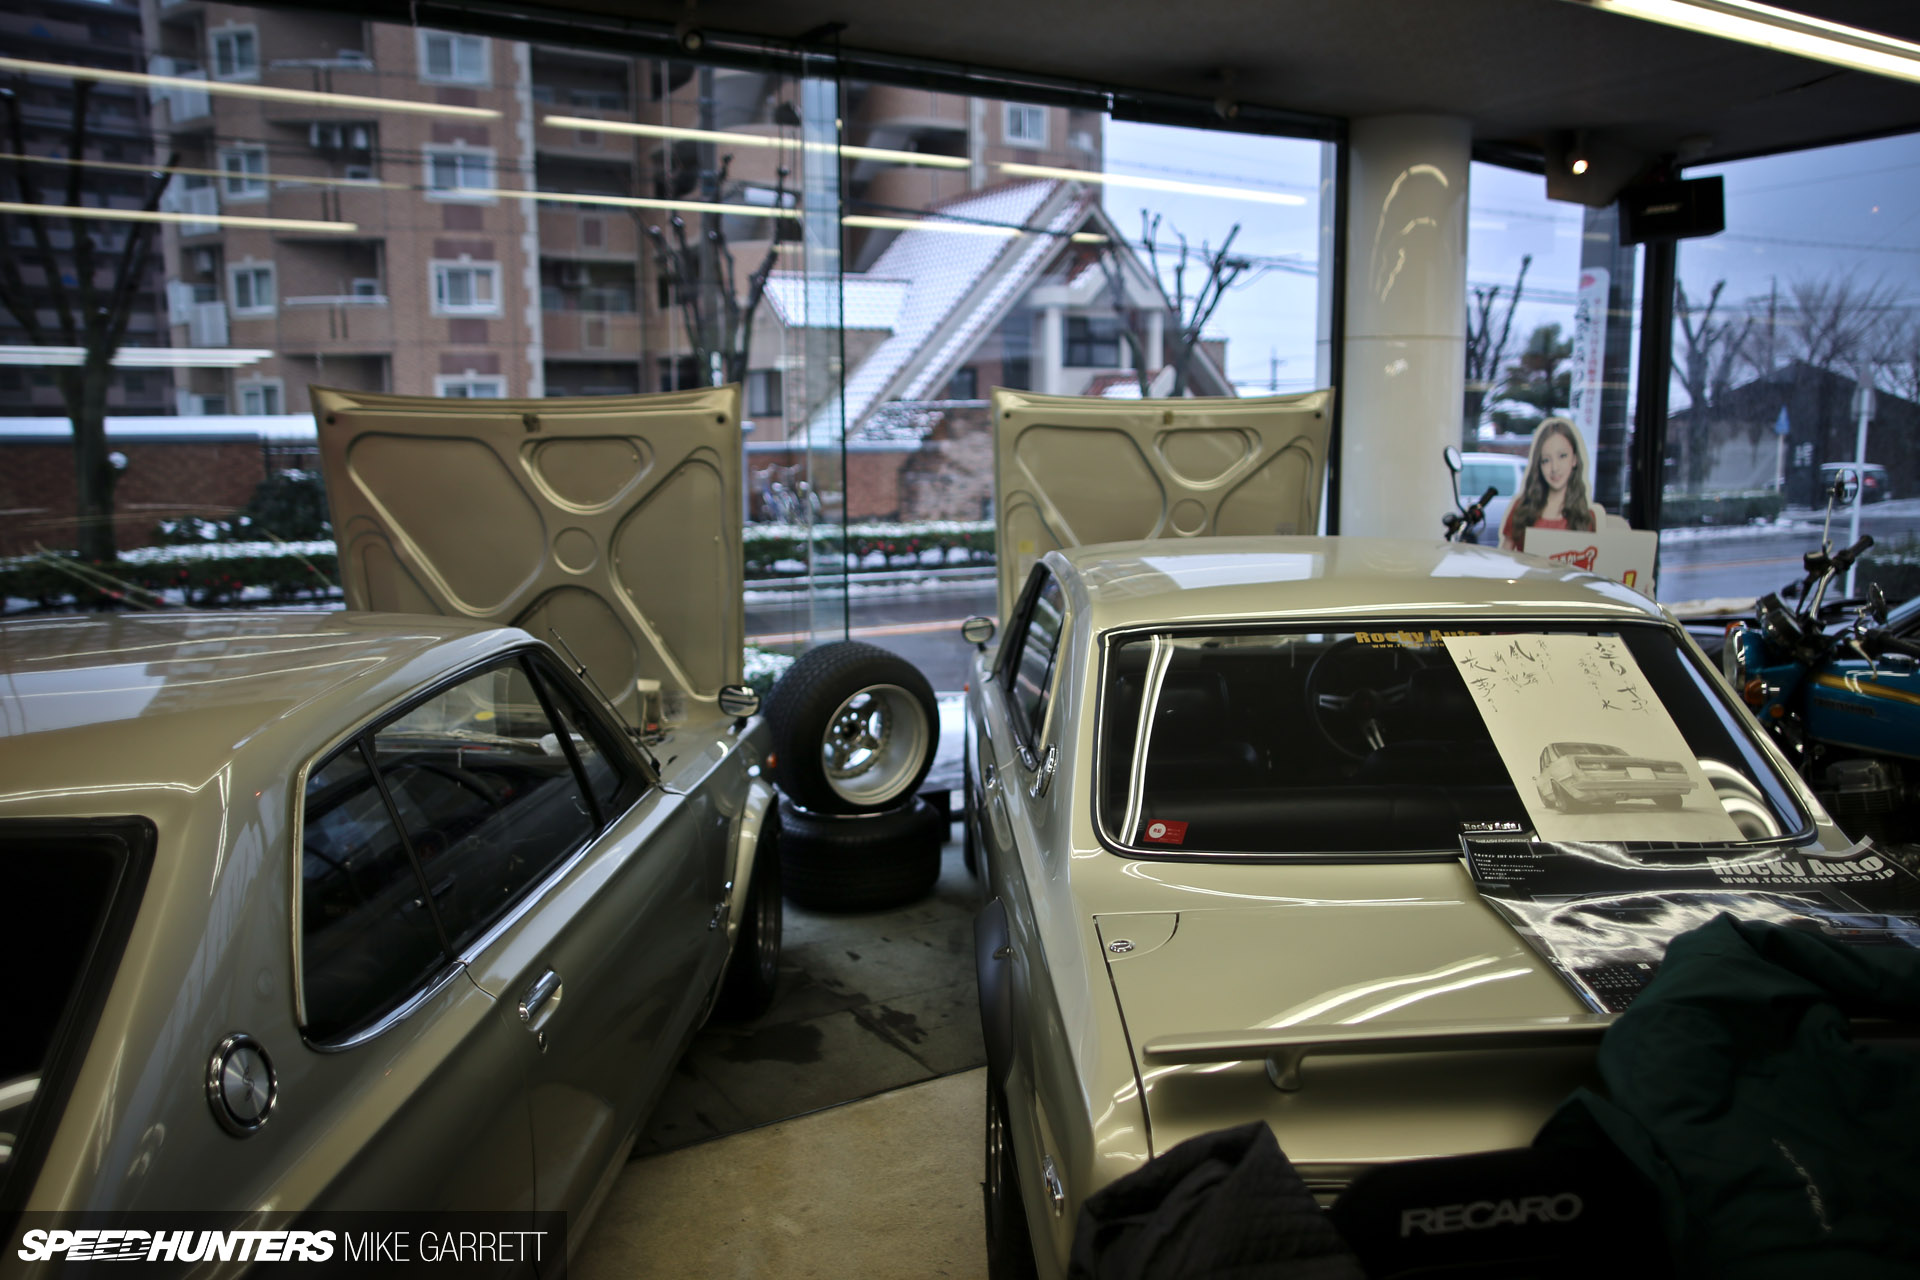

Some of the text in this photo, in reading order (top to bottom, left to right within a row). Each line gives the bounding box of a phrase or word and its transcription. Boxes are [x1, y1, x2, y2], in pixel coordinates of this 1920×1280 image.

[1354, 630, 1424, 643] Rocky
[1706, 856, 1884, 877] Rocky Auto
[1720, 868, 1896, 884] www.rockyauto.co.jp
[1400, 1192, 1583, 1238] RECARO
